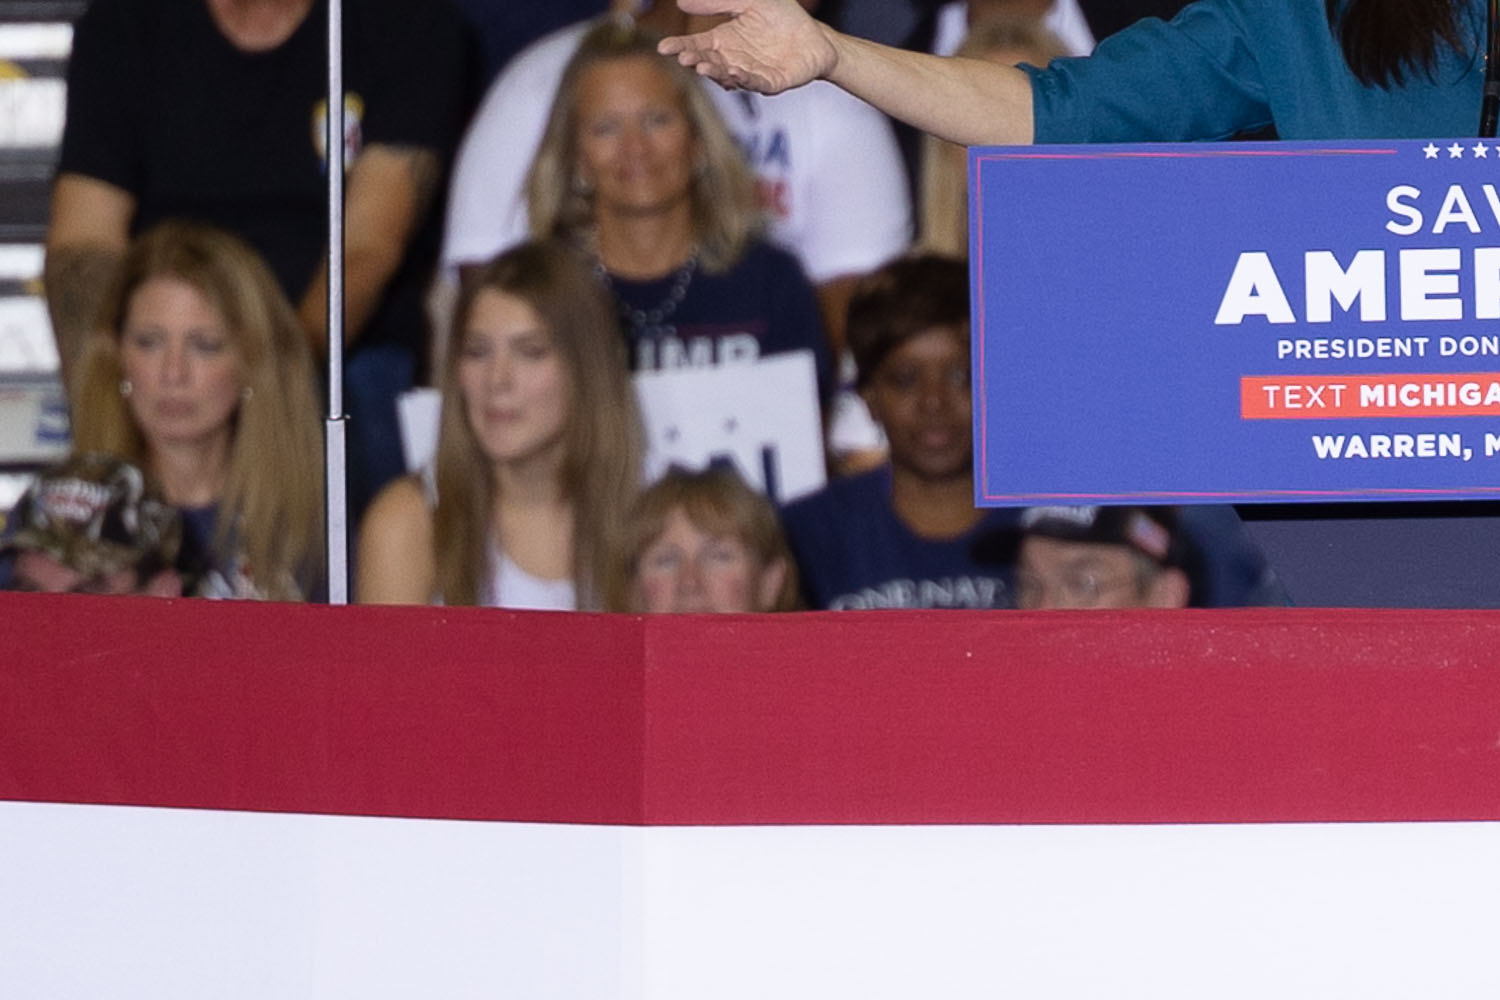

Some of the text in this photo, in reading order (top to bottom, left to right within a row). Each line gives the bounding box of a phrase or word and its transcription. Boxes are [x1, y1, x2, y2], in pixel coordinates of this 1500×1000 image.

[1277, 337, 1430, 359] PRESIDENT
[1262, 384, 1348, 409] TEXT
[1311, 433, 1473, 461] WARREN,
